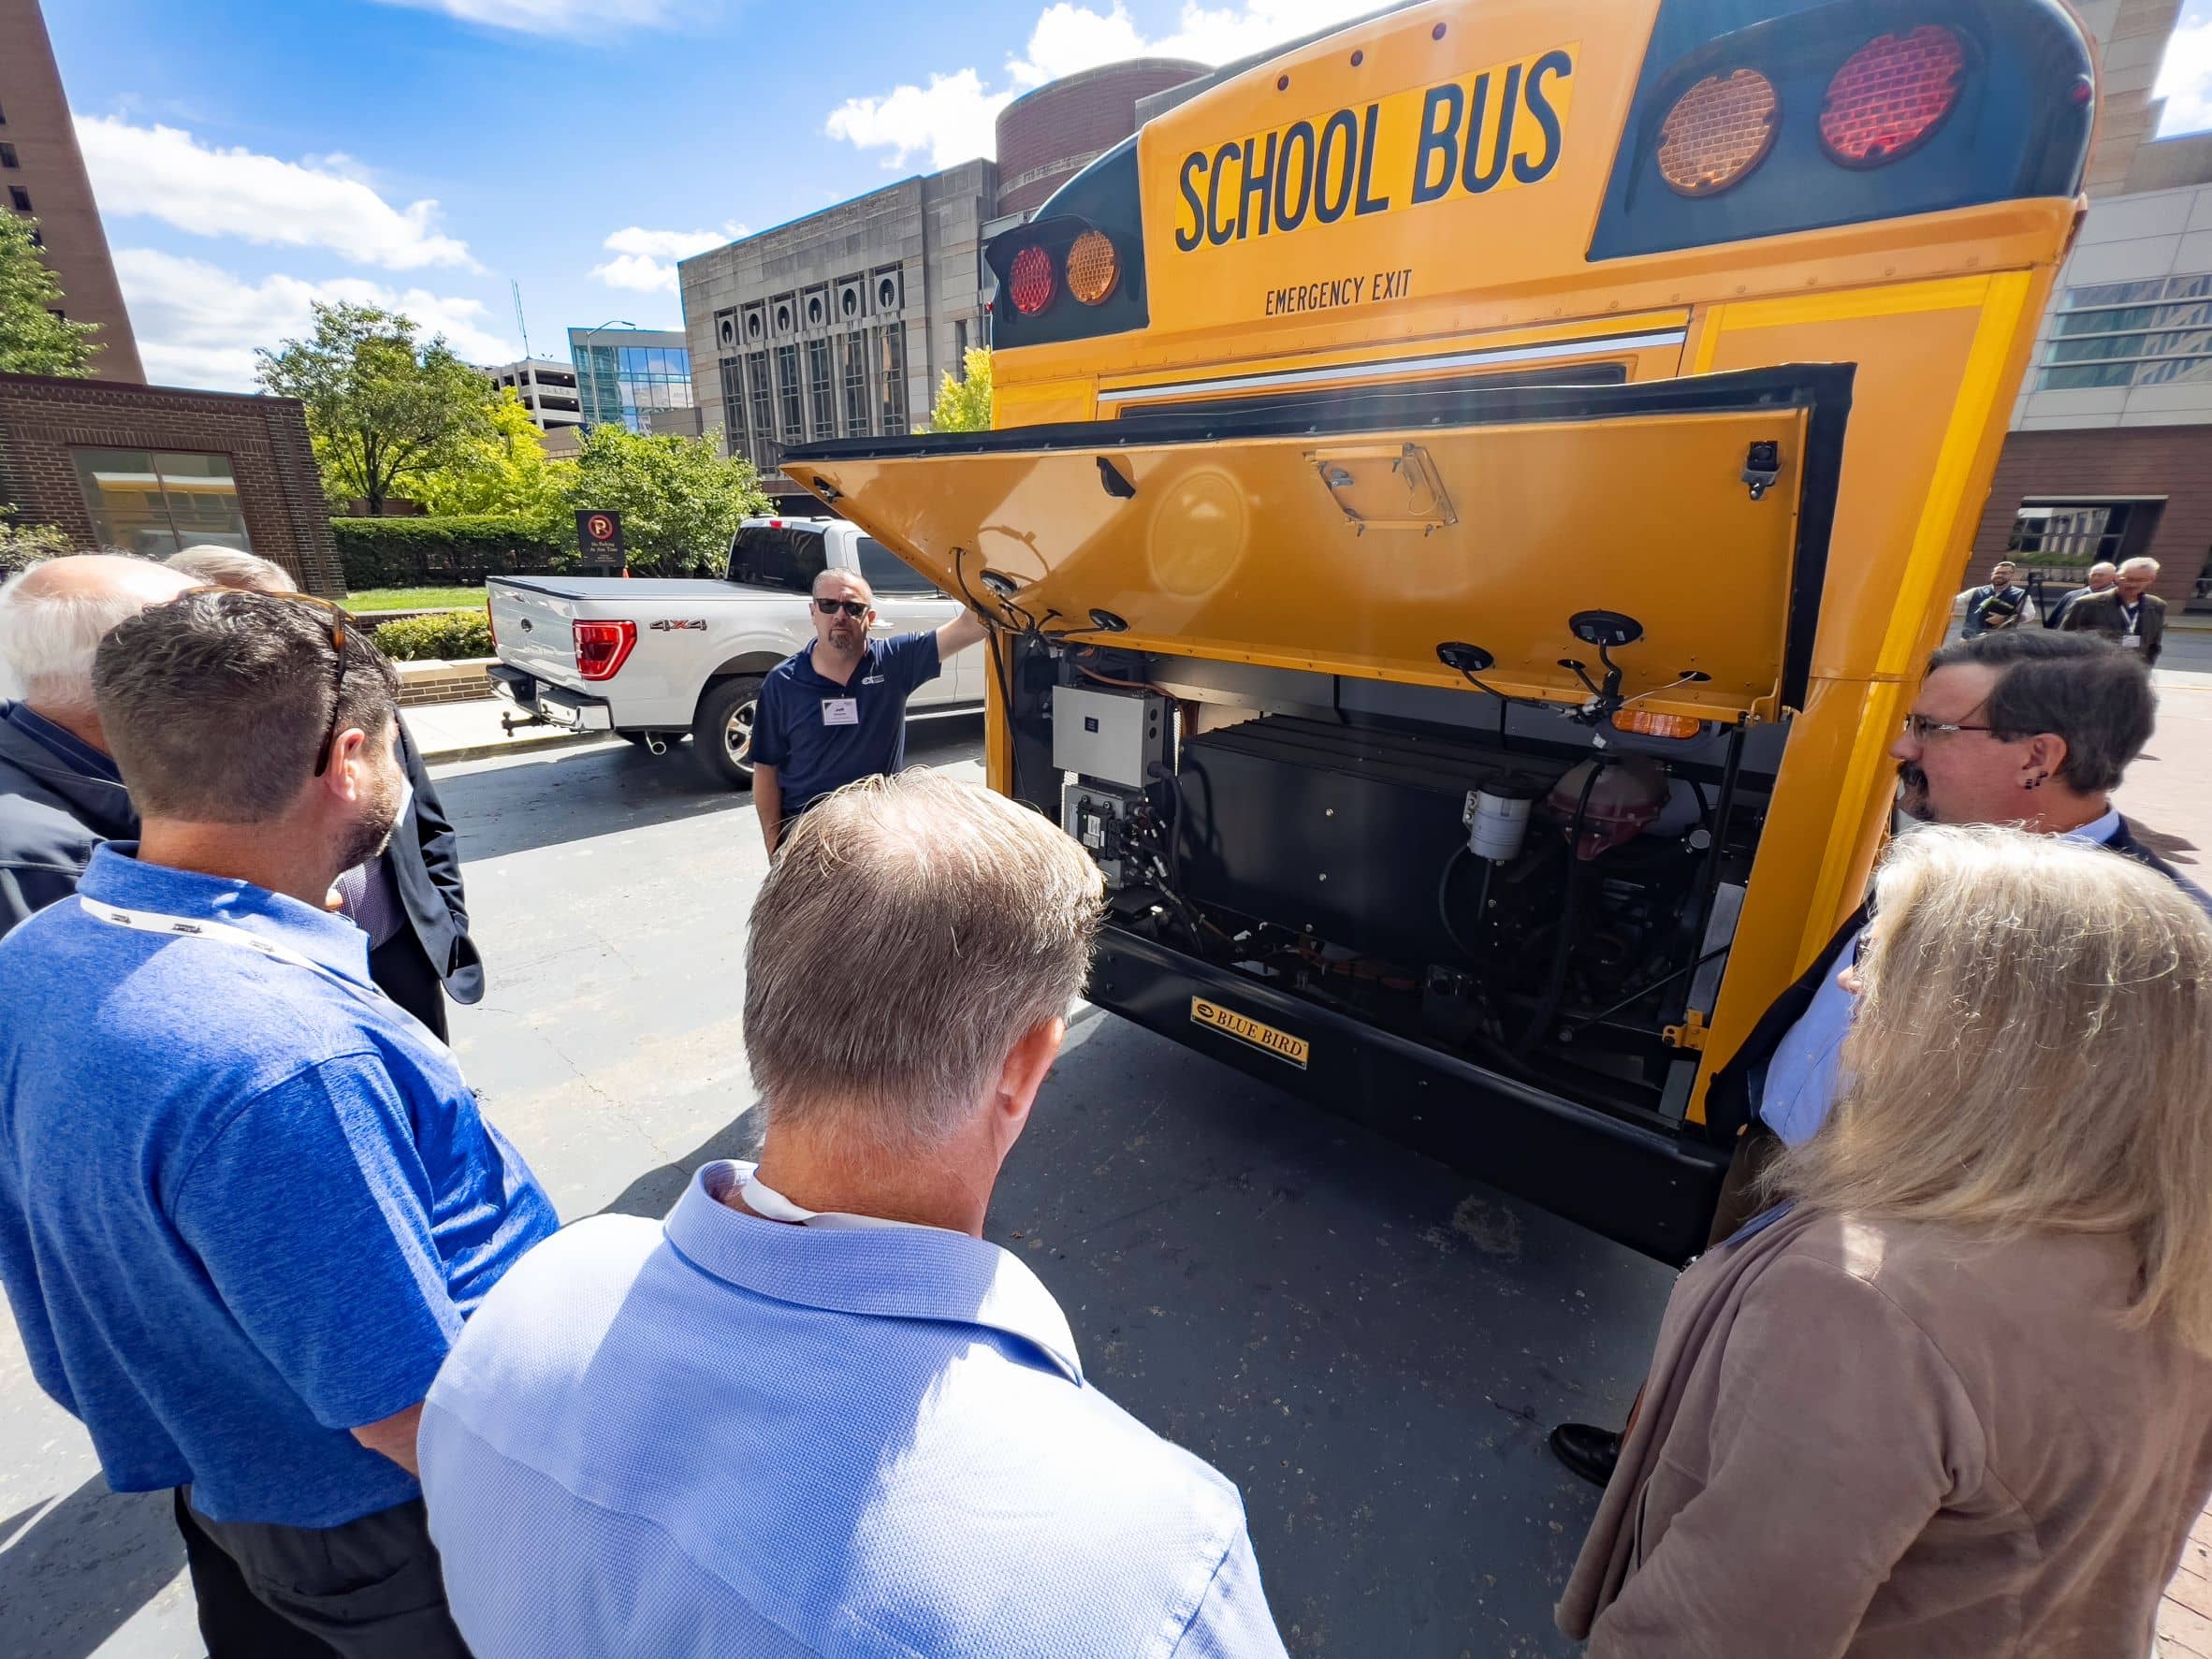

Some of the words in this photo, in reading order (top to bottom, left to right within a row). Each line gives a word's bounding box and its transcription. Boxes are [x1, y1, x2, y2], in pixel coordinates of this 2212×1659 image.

[1175, 104, 1390, 252] SCHOOL
[1411, 50, 1572, 205] BUS
[1265, 276, 1365, 316] EMERGENCY
[1372, 269, 1412, 301] EXIT
[1216, 1010, 1259, 1039] BLUE
[1261, 1028, 1302, 1056] BIRD
